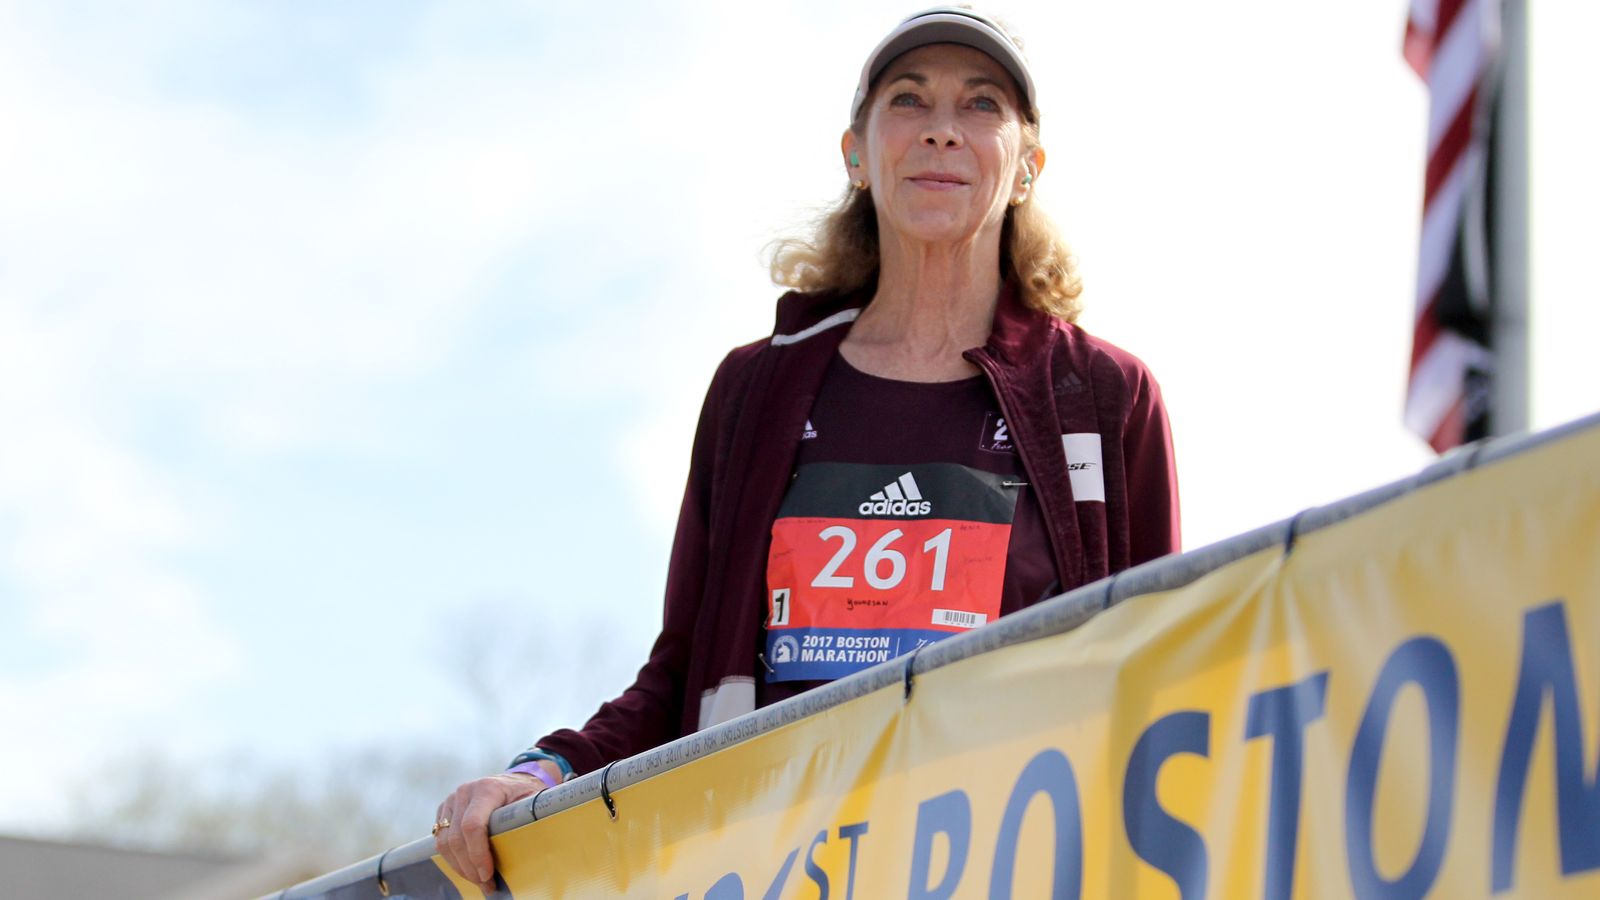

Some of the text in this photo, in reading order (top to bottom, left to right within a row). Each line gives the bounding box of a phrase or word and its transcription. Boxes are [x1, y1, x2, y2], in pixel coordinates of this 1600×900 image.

[1067, 463, 1096, 471] SE
[859, 500, 931, 515] adidas
[810, 526, 952, 591] 261
[775, 593, 785, 622] 1
[802, 635, 890, 648] 2017 BOSTON
[801, 649, 888, 662] MARATHON
